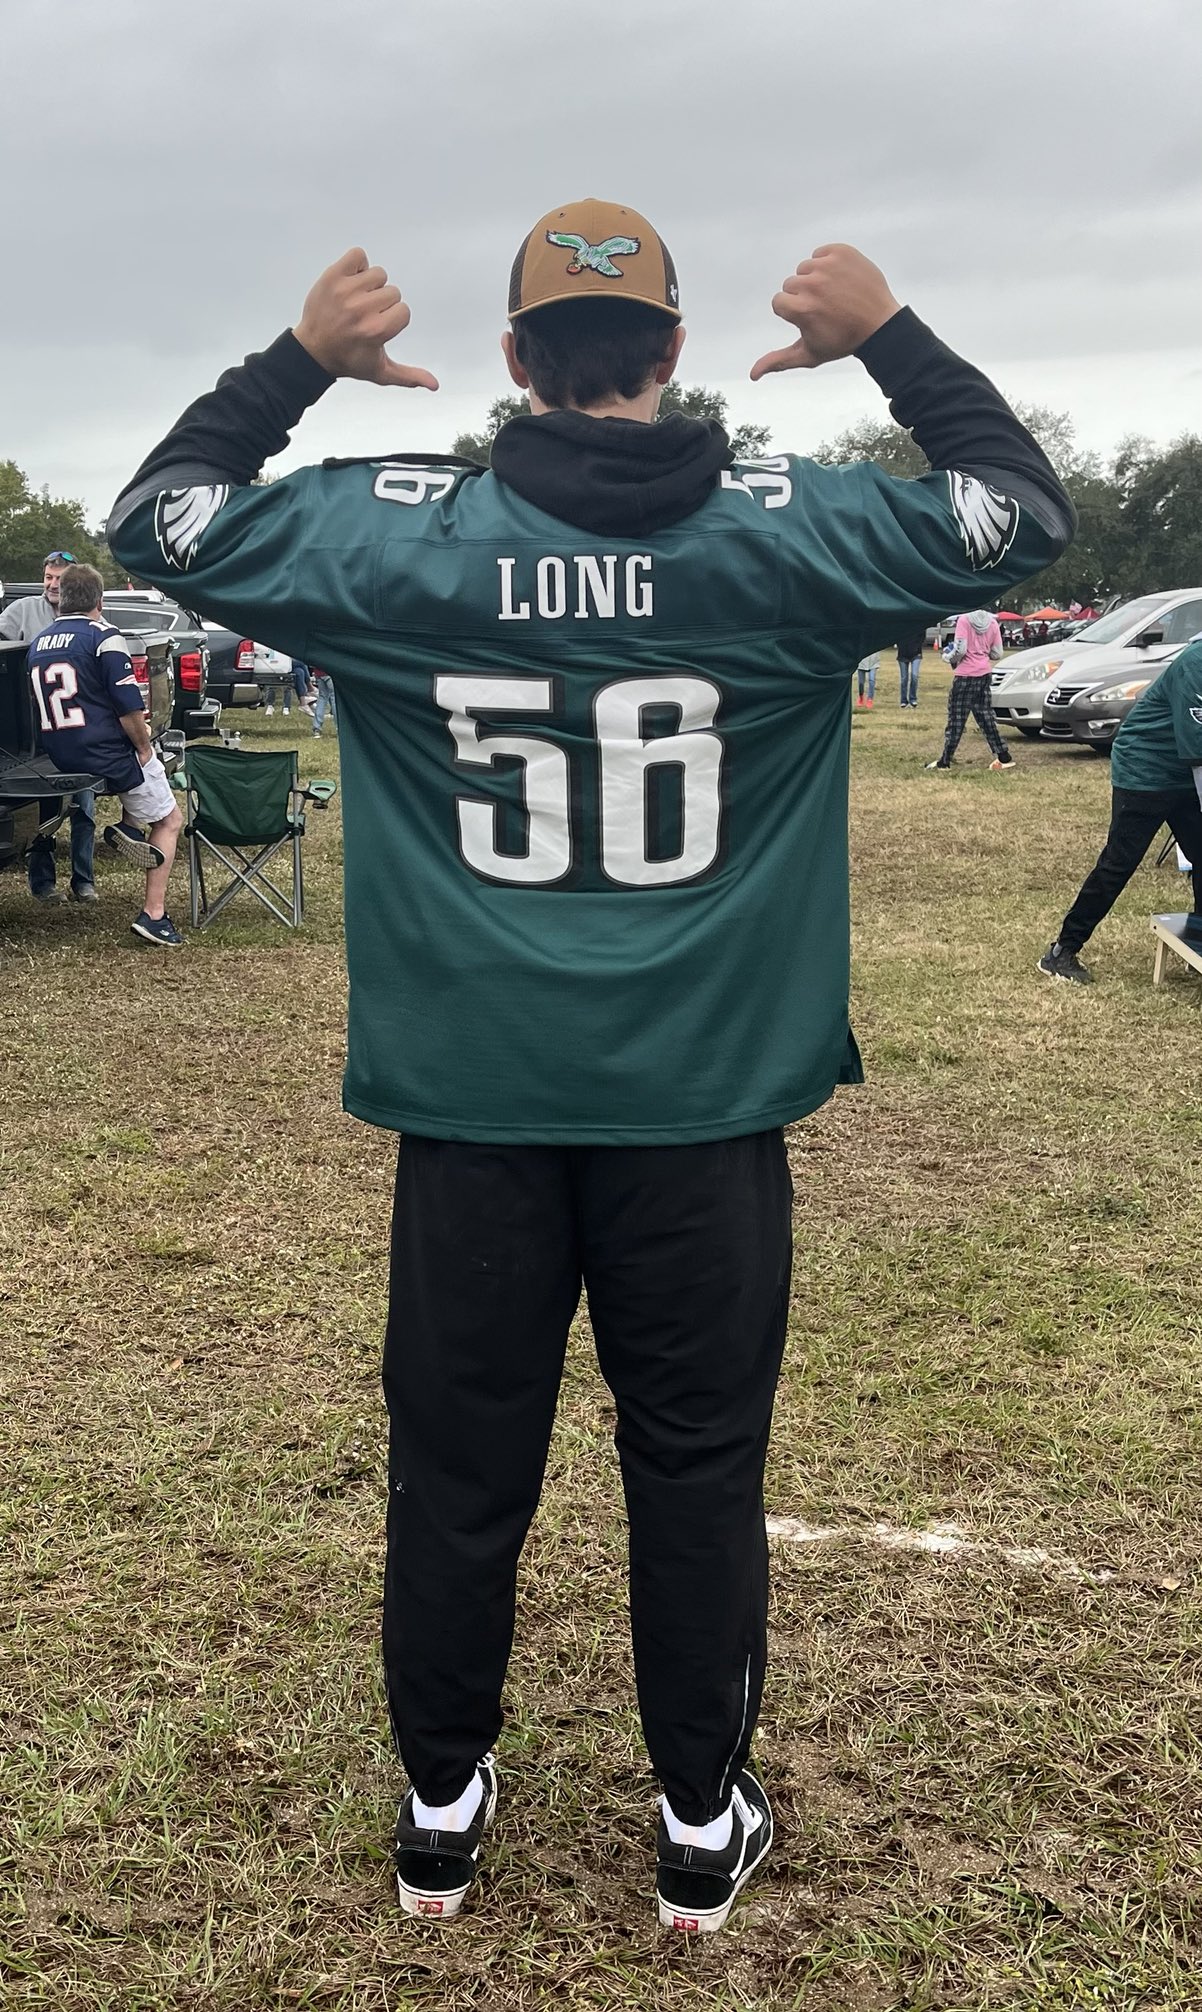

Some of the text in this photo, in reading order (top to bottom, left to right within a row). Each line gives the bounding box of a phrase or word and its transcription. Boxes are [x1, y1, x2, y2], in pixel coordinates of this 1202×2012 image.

[496, 554, 654, 620] LONG
[36, 633, 75, 652] BRADY
[31, 661, 86, 731] 12
[433, 673, 724, 887] 56
